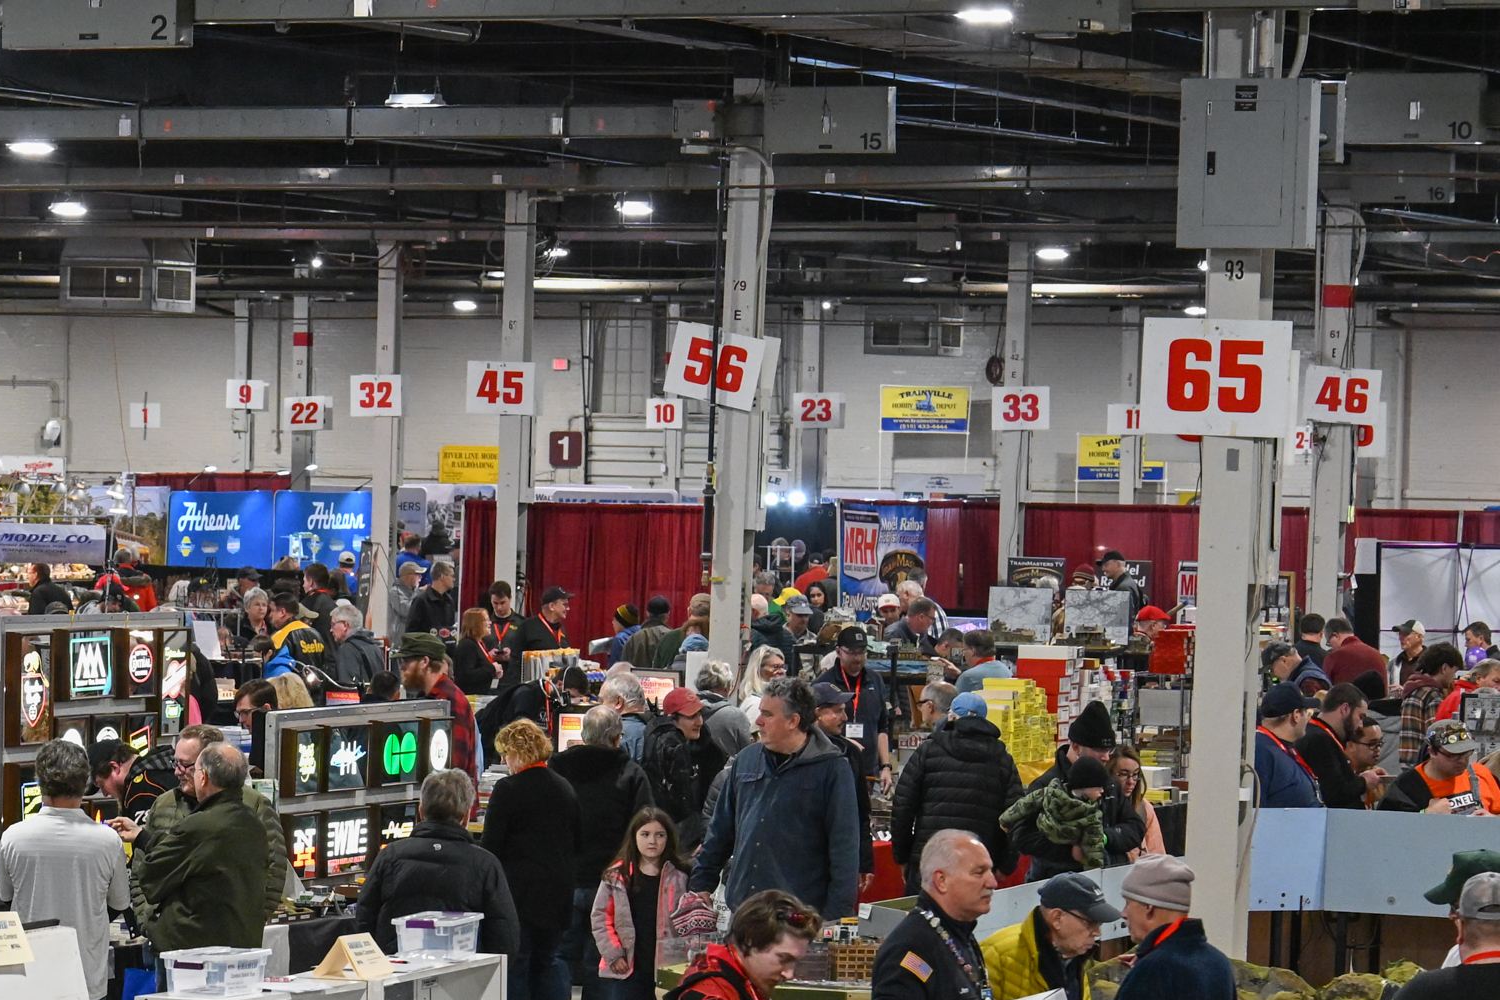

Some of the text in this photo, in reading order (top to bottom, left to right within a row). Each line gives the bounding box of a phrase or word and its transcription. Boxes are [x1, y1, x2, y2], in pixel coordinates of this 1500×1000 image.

[151, 15, 168, 40] 2
[1448, 121, 1471, 140] 10
[859, 132, 882, 151] 15
[1428, 187, 1444, 200] 16
[1225, 260, 1244, 280] 93
[733, 280, 747, 292] 79
[734, 309, 741, 321] E
[1329, 331, 1340, 339] 61
[1332, 348, 1337, 358] E
[683, 337, 748, 392] 56
[1166, 338, 1264, 413] 65
[239, 384, 252, 404] 9
[359, 382, 392, 408] 32
[476, 370, 524, 404] 45
[899, 390, 954, 399] TRAINVILLE
[1315, 377, 1369, 413] 46
[142, 408, 148, 423] 1
[290, 402, 318, 424] 22
[654, 404, 674, 423] 10
[801, 399, 832, 421] 23
[1002, 393, 1040, 422] 33
[1126, 409, 1140, 430] 11
[558, 436, 569, 461] 1
[451, 461, 494, 469] RAILROADING
[307, 502, 365, 530] Athearn
[398, 502, 421, 511] HERS
[177, 502, 241, 532] Athearn
[0, 533, 60, 544] MODEL
[65, 535, 92, 544] CO.
[1449, 794, 1474, 807] ONEL
